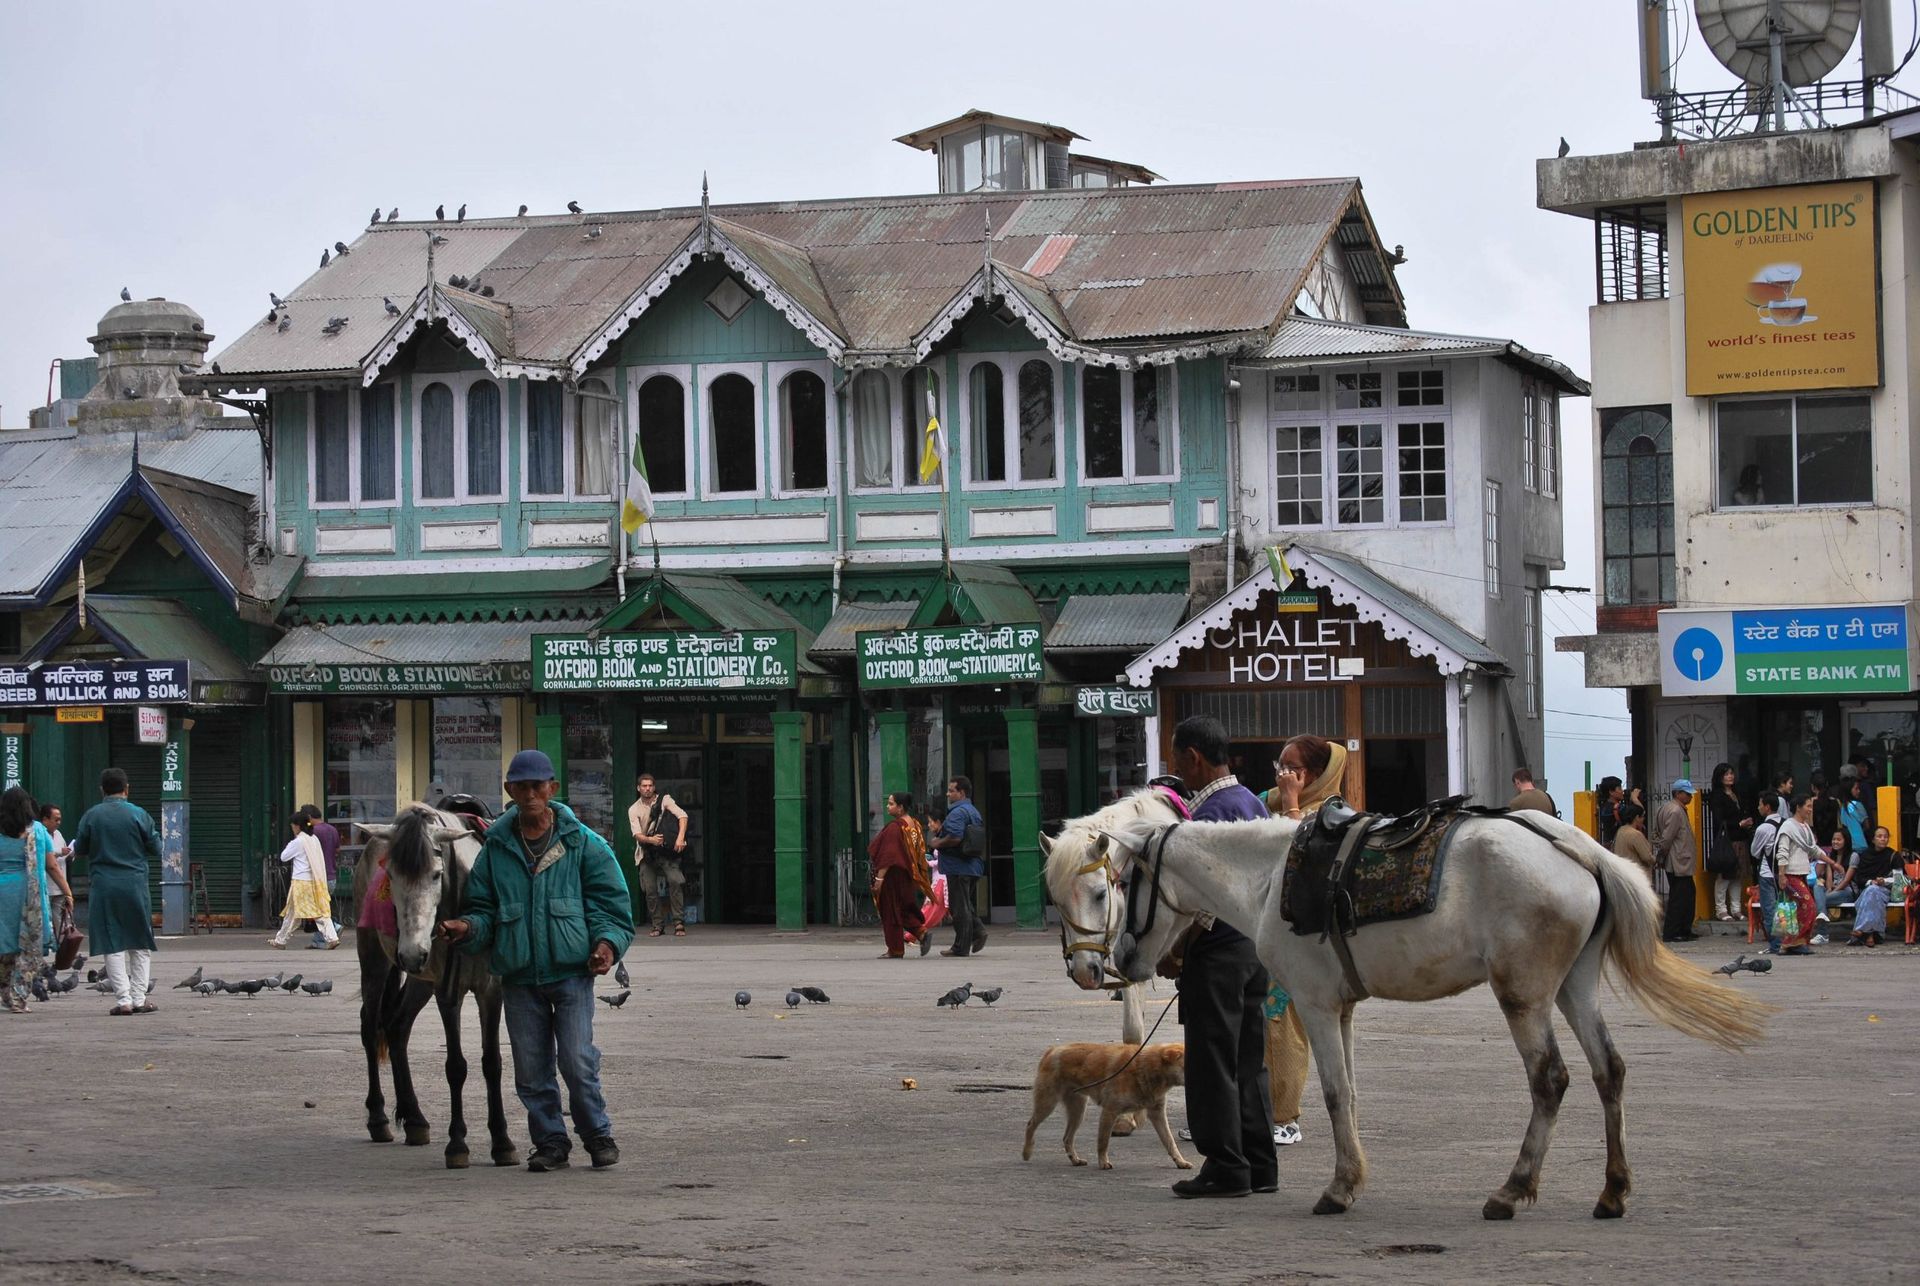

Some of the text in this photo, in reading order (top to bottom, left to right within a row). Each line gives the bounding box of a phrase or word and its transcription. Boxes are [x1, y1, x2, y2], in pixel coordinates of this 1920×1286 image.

[1693, 203, 1856, 237] GOLDEN TIPS
[1735, 232, 1814, 248] of DARJEELING
[1707, 331, 1856, 348] world's finest teas
[1717, 366, 1846, 380] www.goldentipstea.com
[1210, 618, 1361, 649] CHALET
[1743, 618, 1899, 640] स्टेट बैंक ए टी एम
[612, 639, 637, 658] बुक
[923, 634, 945, 657] बुक
[146, 668, 174, 682] सन
[271, 667, 333, 683] OXFORD
[338, 667, 383, 683] BOOK
[388, 668, 400, 682] &
[403, 665, 504, 683] STATIONERY
[545, 655, 788, 679] OXFORD BOOK AND STATIONERY Co.
[866, 660, 914, 680] OXFORD
[918, 658, 949, 677] BOOK
[949, 661, 962, 670] AND
[962, 653, 1026, 675] STATIONERY
[1229, 652, 1353, 683] HOTEL
[1746, 664, 1901, 682] STATE BANK ATM
[543, 680, 592, 689] GORKHALAND
[660, 678, 719, 687] DARJEELING
[910, 674, 958, 685] GORKHALAND
[45, 685, 107, 700] MULLICK
[113, 686, 141, 699] AND
[148, 684, 178, 698] SON
[1108, 687, 1153, 714] होटल
[141, 712, 164, 725] Silver
[435, 715, 457, 725] BOOKS
[6, 736, 18, 777] BRASS
[162, 780, 182, 791] CRAFTS
